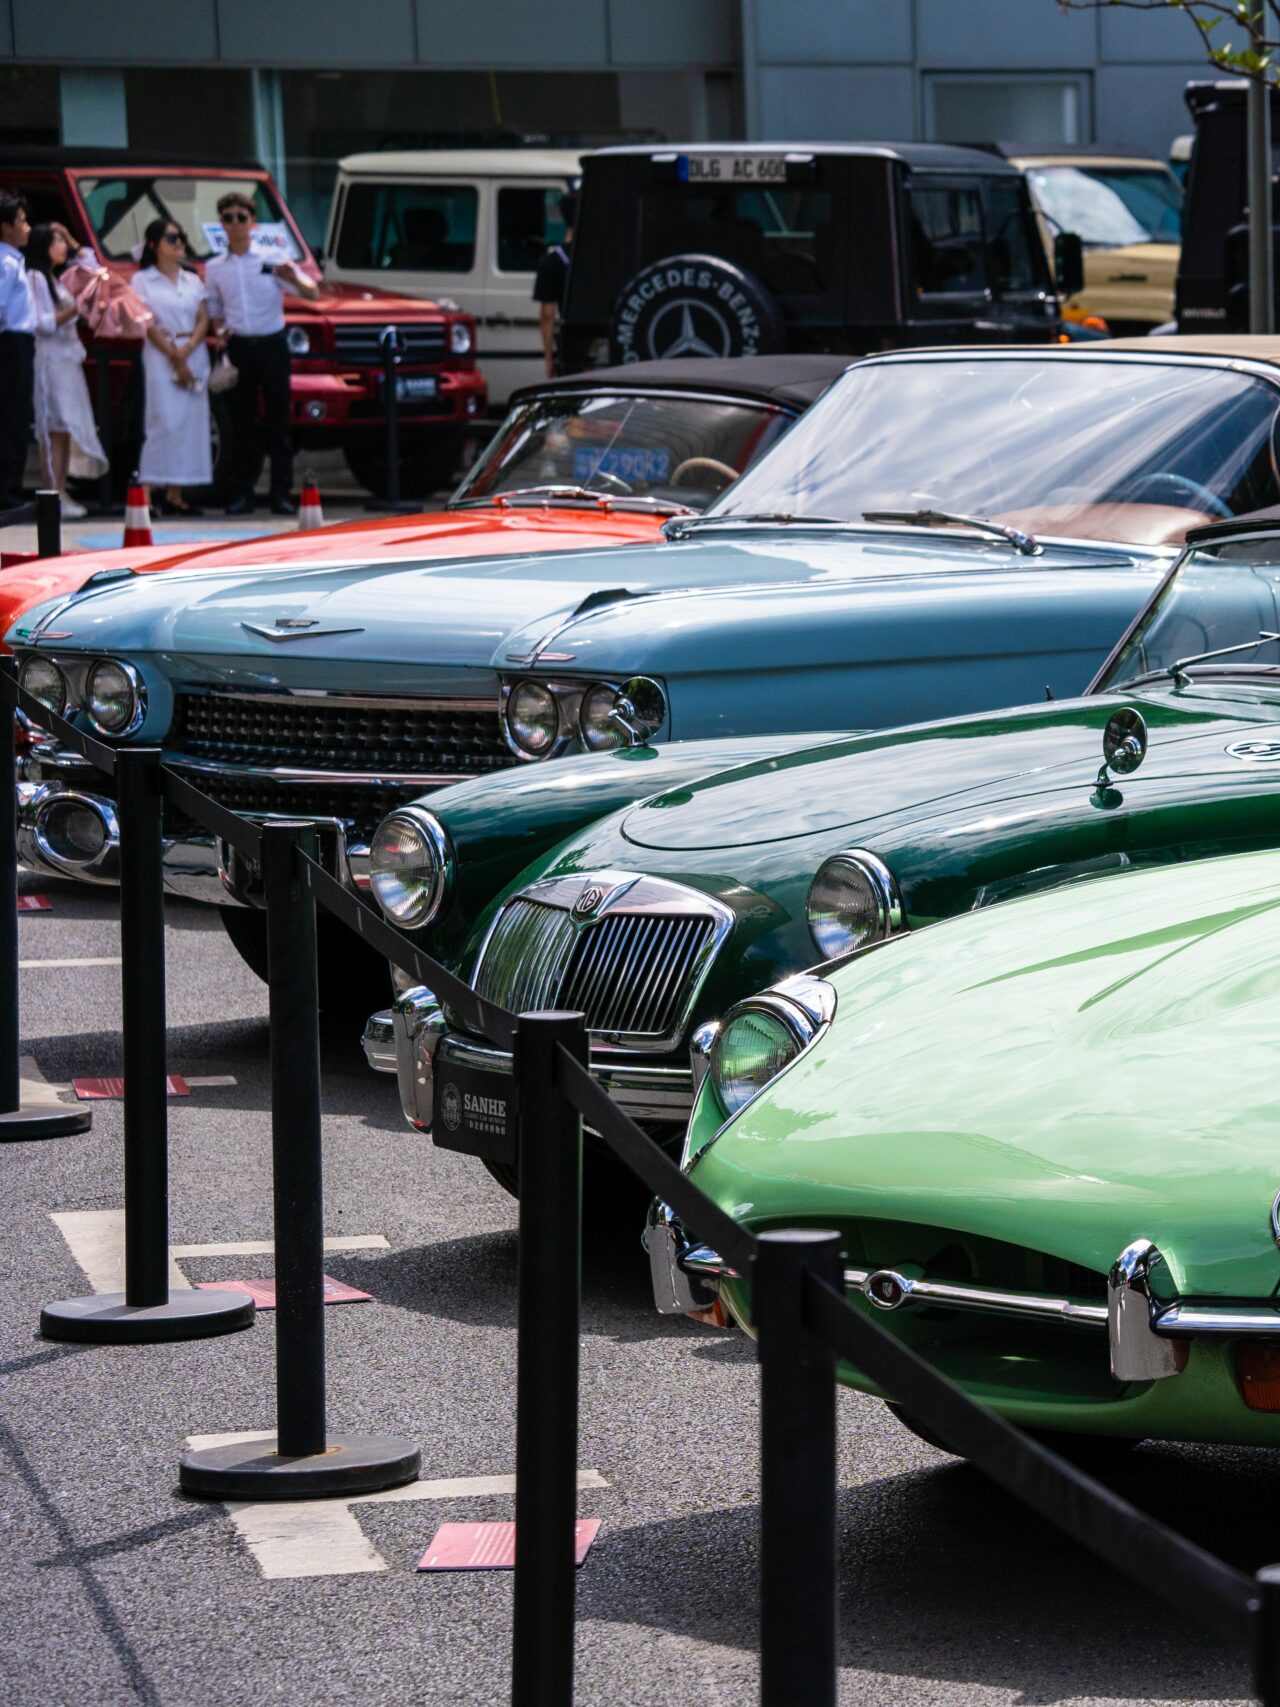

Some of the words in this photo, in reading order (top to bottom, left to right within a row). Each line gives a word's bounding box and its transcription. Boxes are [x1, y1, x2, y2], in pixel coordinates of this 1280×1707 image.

[733, 158, 753, 178] AC
[577, 888, 599, 911] MG
[464, 1093, 506, 1117] SANHE
